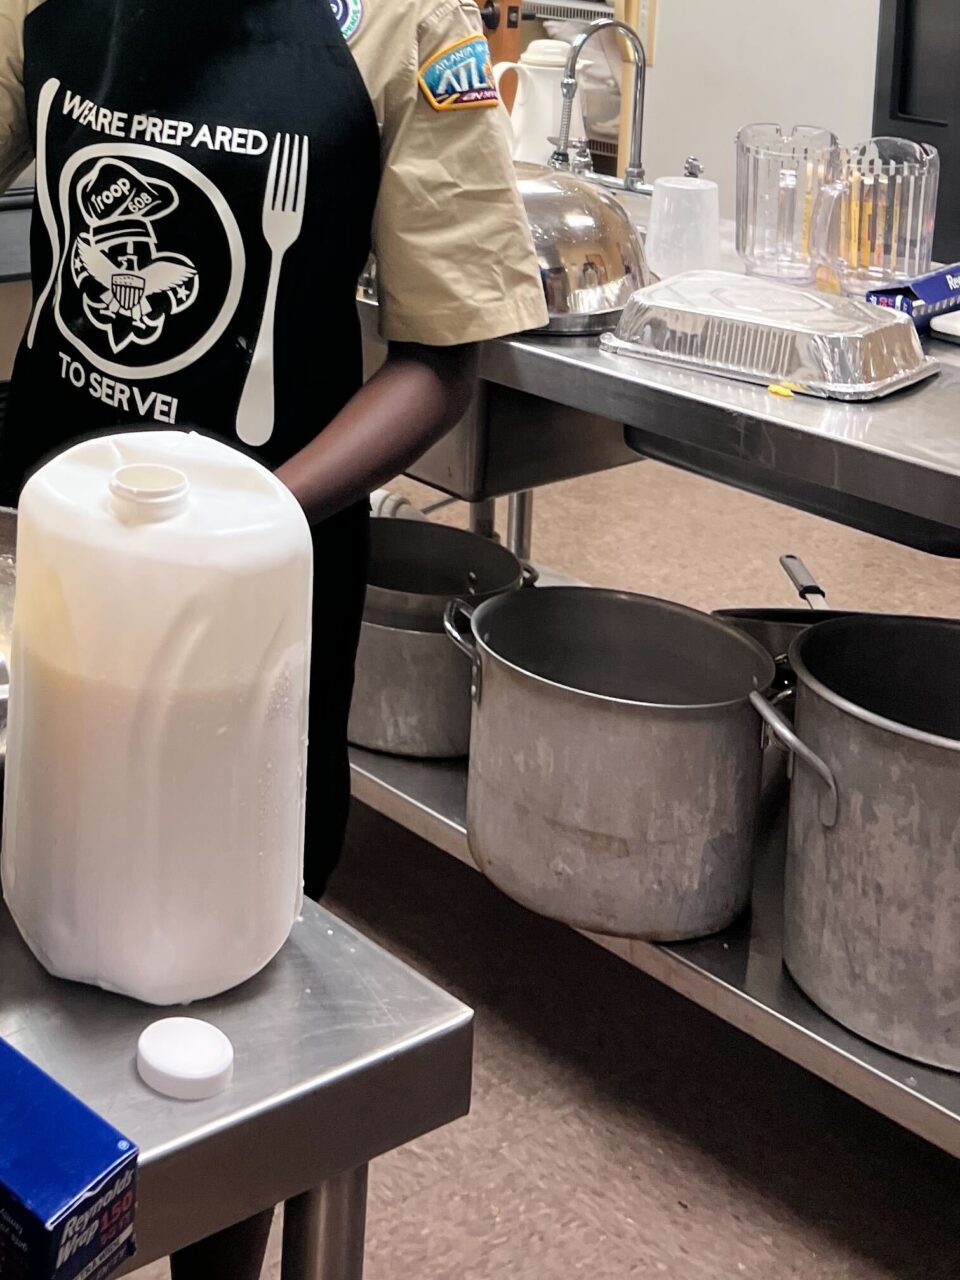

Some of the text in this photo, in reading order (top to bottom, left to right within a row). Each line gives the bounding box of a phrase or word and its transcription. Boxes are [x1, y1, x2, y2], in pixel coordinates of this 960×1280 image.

[130, 114, 269, 156] PREPARED
[91, 177, 132, 214] Troop
[128, 192, 153, 213] 608
[59, 351, 86, 388] TO
[61, 1170, 133, 1242] Reynolds
[102, 1192, 132, 1229] 150
[57, 1220, 99, 1269] Wrap
